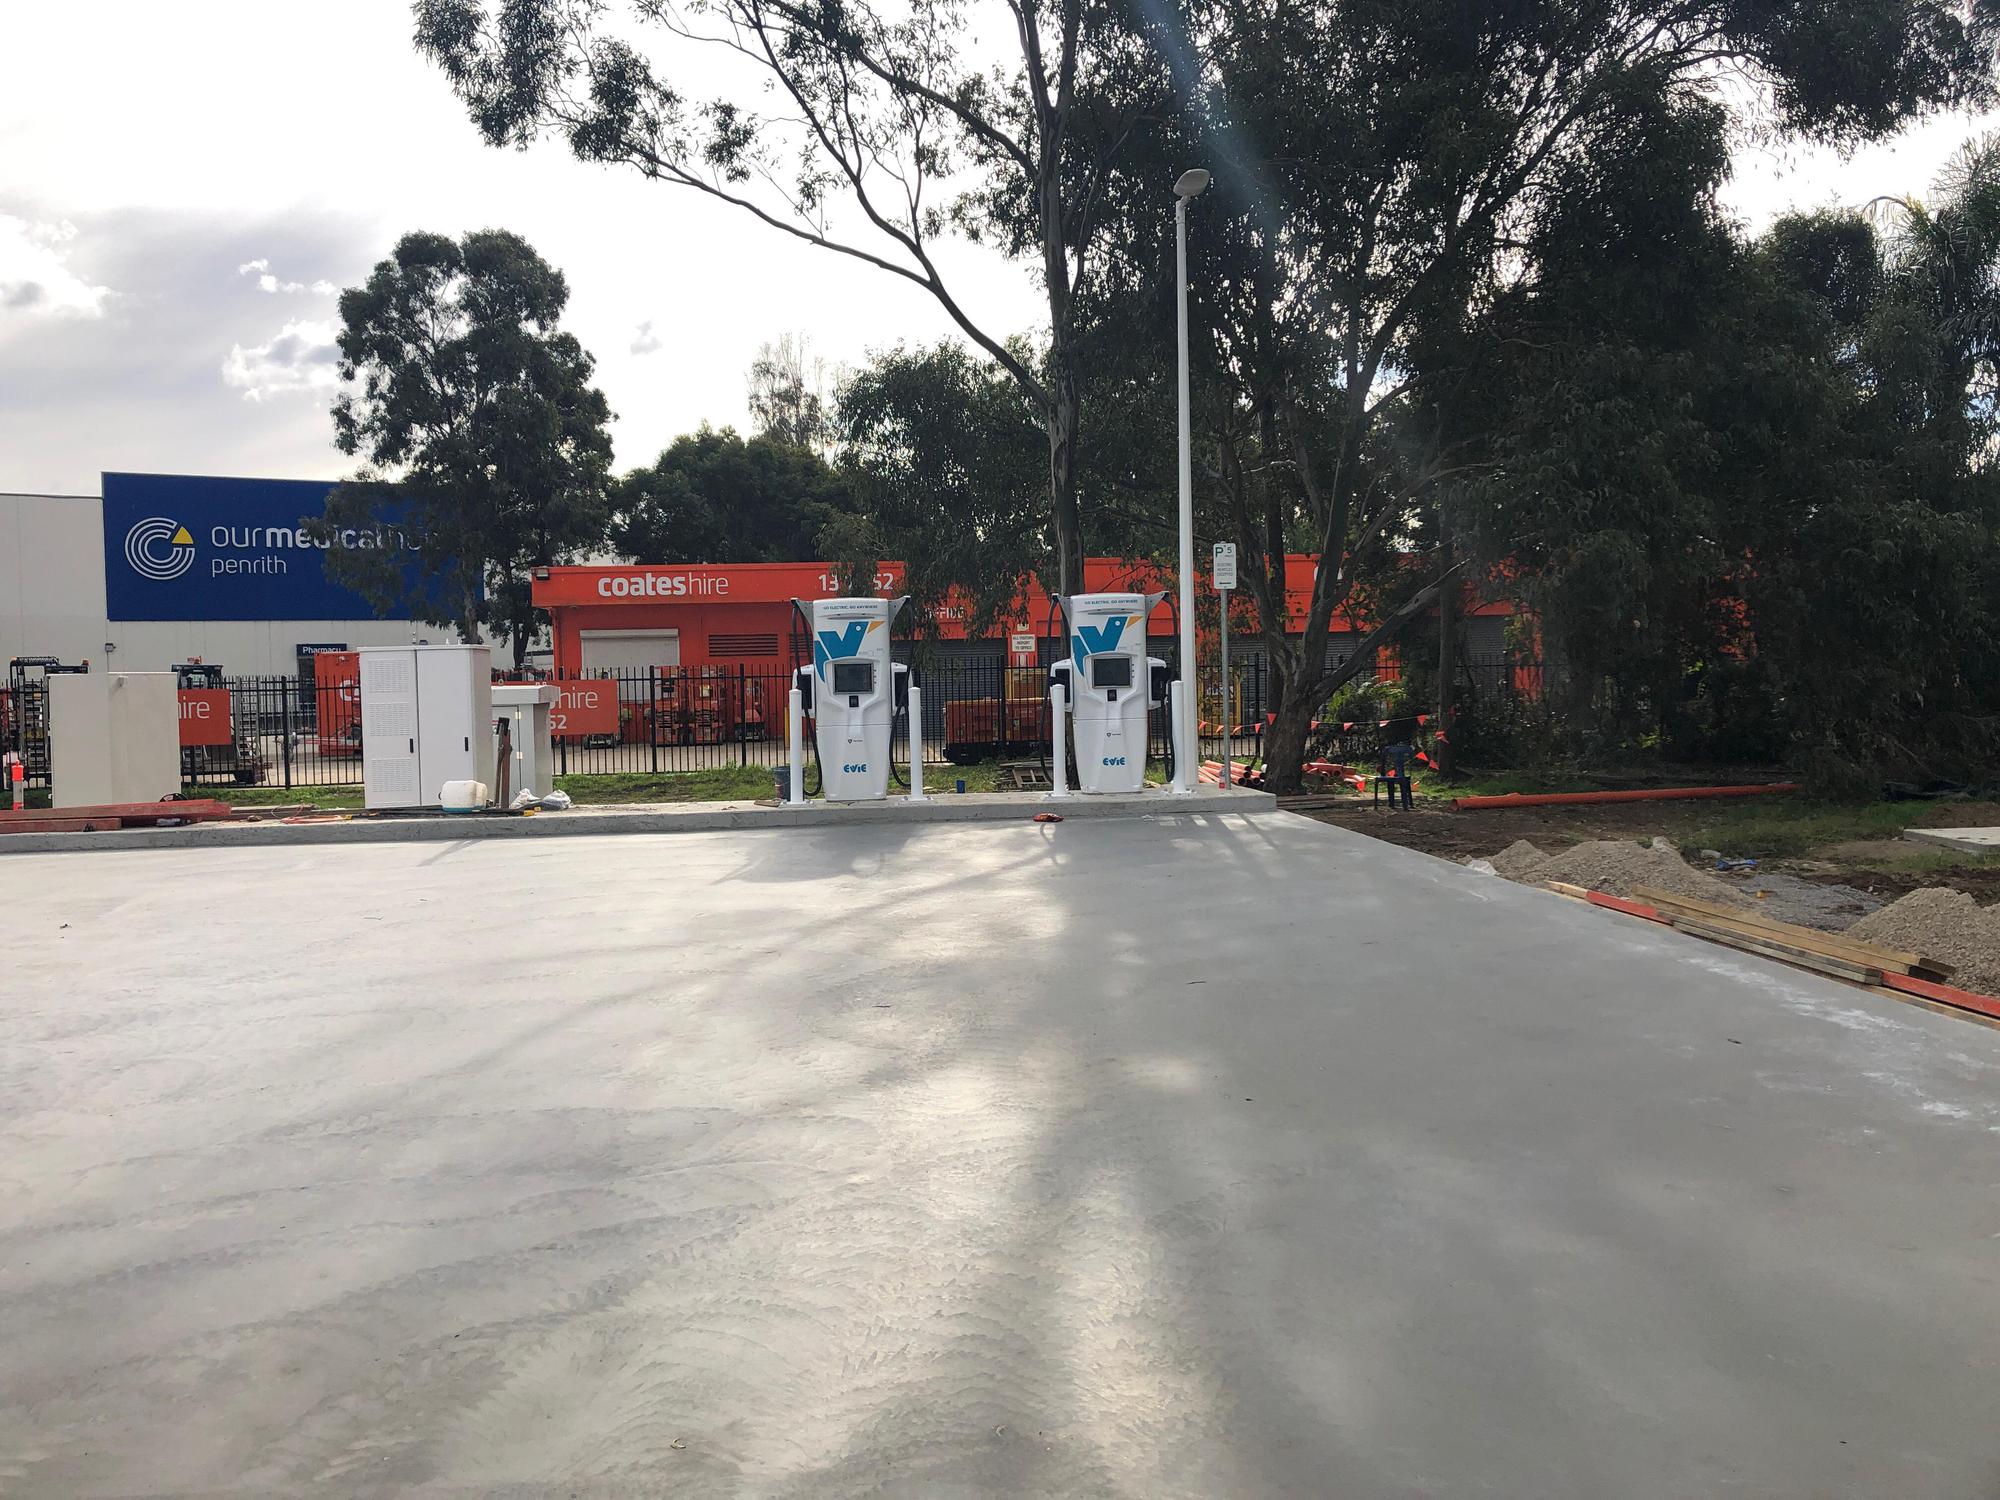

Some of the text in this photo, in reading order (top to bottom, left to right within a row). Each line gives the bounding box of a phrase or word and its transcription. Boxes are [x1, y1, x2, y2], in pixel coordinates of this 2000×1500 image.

[1215, 546, 1223, 557] P
[212, 555, 287, 578] penrith
[818, 573, 839, 592] 13
[872, 572, 894, 592] 52
